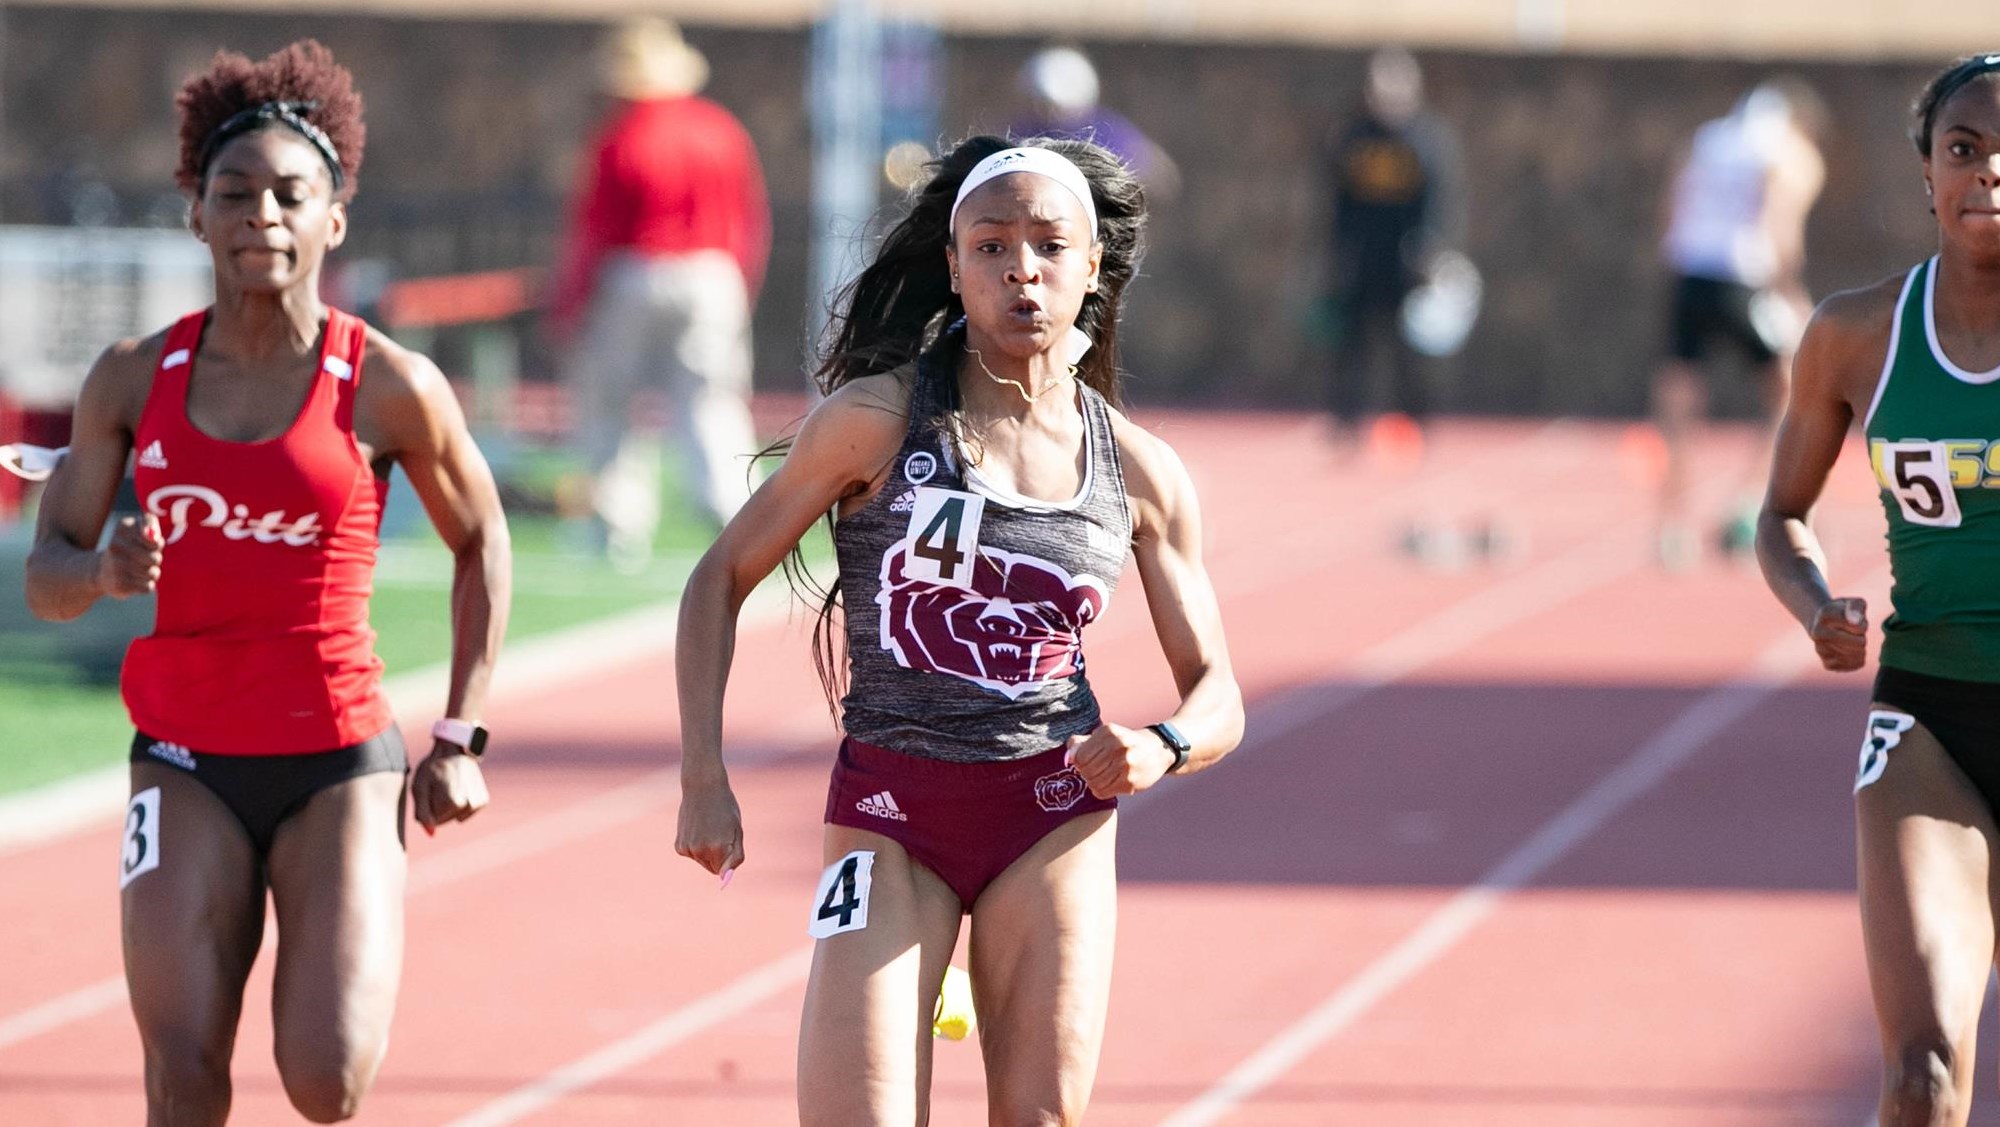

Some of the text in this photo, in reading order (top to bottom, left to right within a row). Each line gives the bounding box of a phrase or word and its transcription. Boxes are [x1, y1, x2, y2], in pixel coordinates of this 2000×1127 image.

[910, 467, 929, 475] UNITE
[1895, 450, 1944, 519] 5
[147, 484, 322, 546] Pitt
[914, 497, 966, 580] 4
[124, 802, 148, 875] 3
[856, 802, 908, 822] adidas
[817, 856, 860, 928] 4
